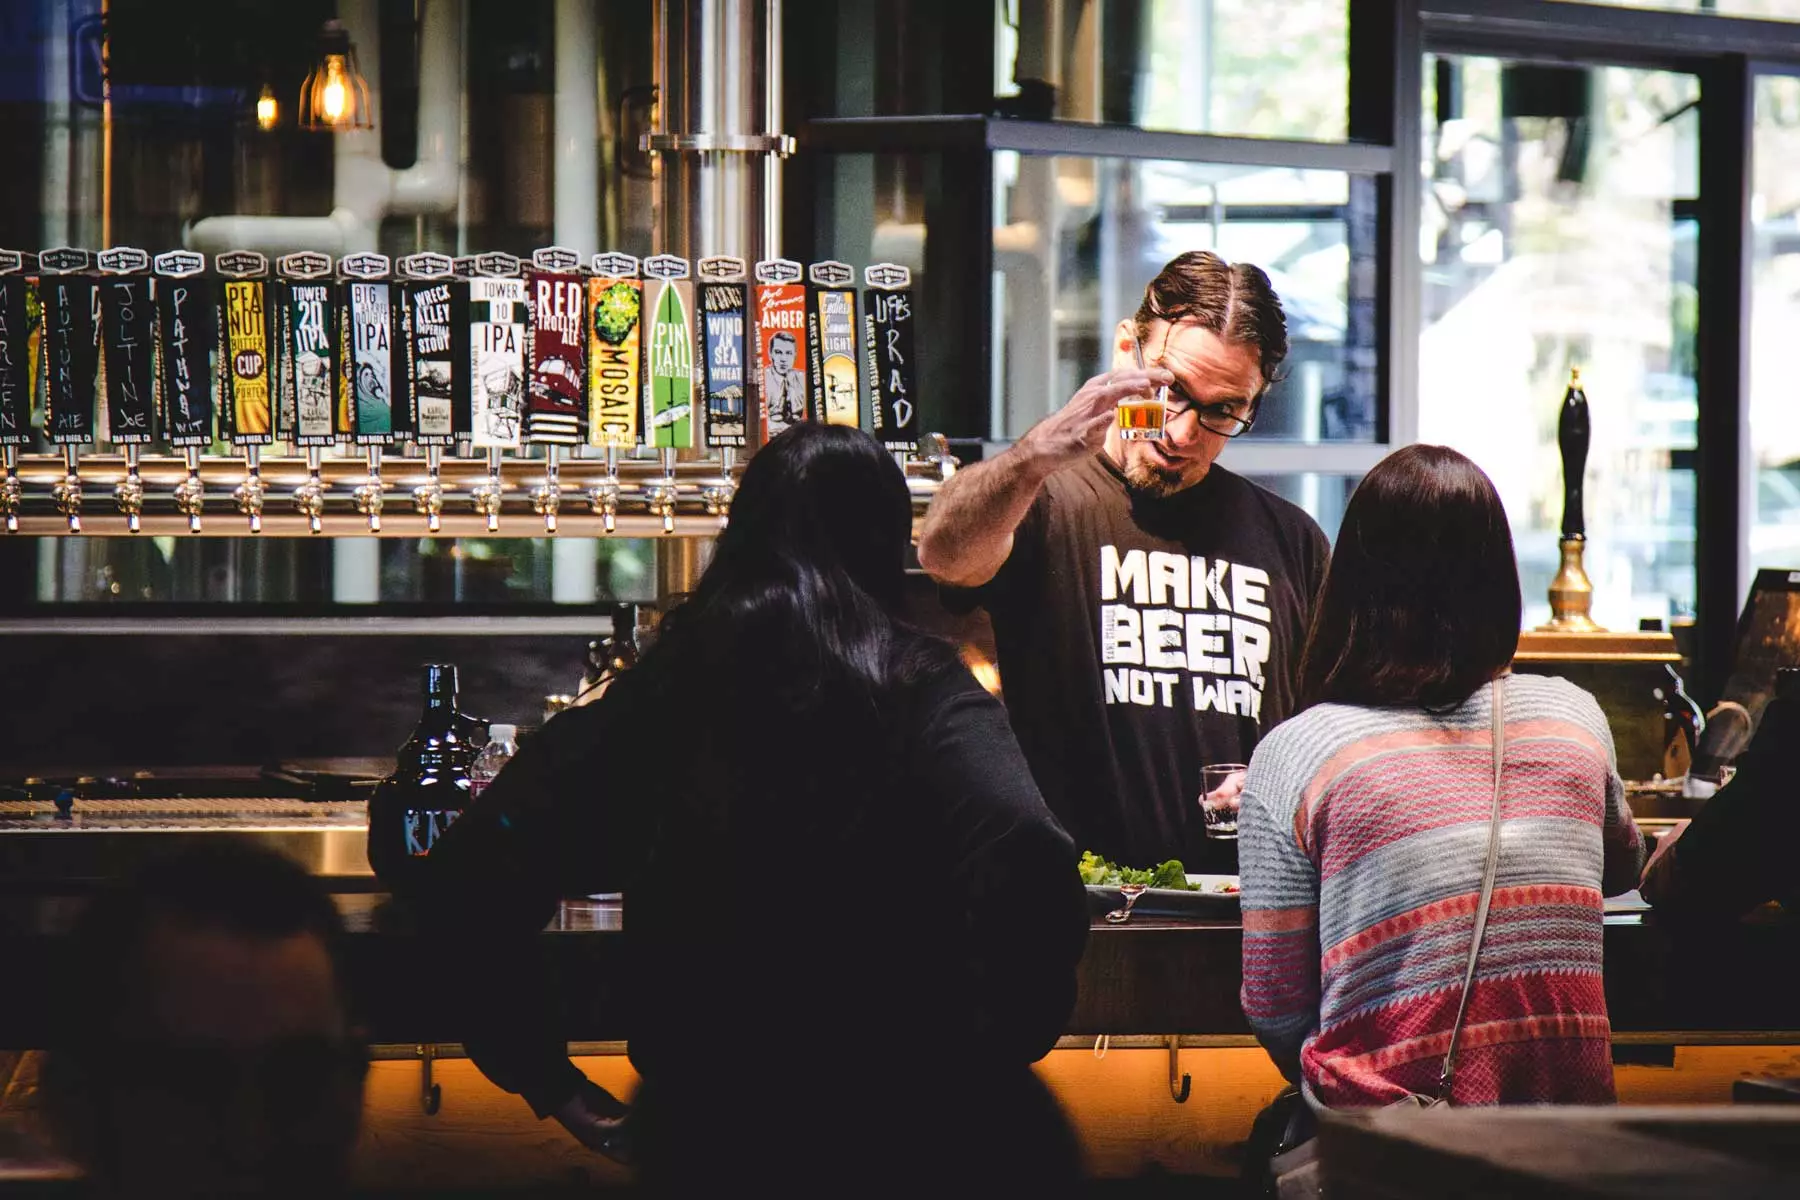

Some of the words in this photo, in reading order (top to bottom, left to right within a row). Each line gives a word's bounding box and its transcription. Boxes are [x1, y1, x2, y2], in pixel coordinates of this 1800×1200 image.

[229, 286, 262, 314] PEA
[292, 286, 327, 301] TOWER
[355, 287, 376, 304] BIG
[414, 284, 450, 307] WRECK
[484, 282, 518, 299] TOWER
[537, 280, 582, 319] RED
[298, 301, 322, 331] 20
[416, 304, 450, 325] ALLEY
[495, 303, 508, 319] 10
[762, 310, 804, 329] AMBER
[231, 311, 262, 337] NUT
[416, 325, 450, 338] IMPERIAL
[538, 314, 581, 334] TROLLEY
[656, 322, 685, 344] PIN
[707, 317, 743, 336] WIND
[809, 312, 818, 347] KARL'S
[865, 314, 876, 348] KARL'S
[231, 337, 264, 350] BUTTER
[357, 323, 388, 350] IPA
[417, 335, 450, 354] STOUT
[483, 325, 516, 353] IPA
[561, 330, 578, 346] ALE
[719, 335, 733, 348] AN
[825, 337, 851, 351] LIGHT
[237, 355, 262, 375] CUP
[654, 344, 689, 368] TAIL
[715, 347, 738, 366] SEA
[811, 347, 821, 386] LIMITED
[711, 367, 741, 382] WHEAT
[868, 349, 880, 388] LIMITED
[236, 387, 265, 399] PORTER
[601, 349, 629, 433] MOSAIC
[871, 389, 883, 429] RELEASE
[175, 420, 203, 433] WIT
[1101, 545, 1271, 623] MAKE
[1101, 604, 1271, 680] BEER
[1104, 668, 1179, 708] NOT
